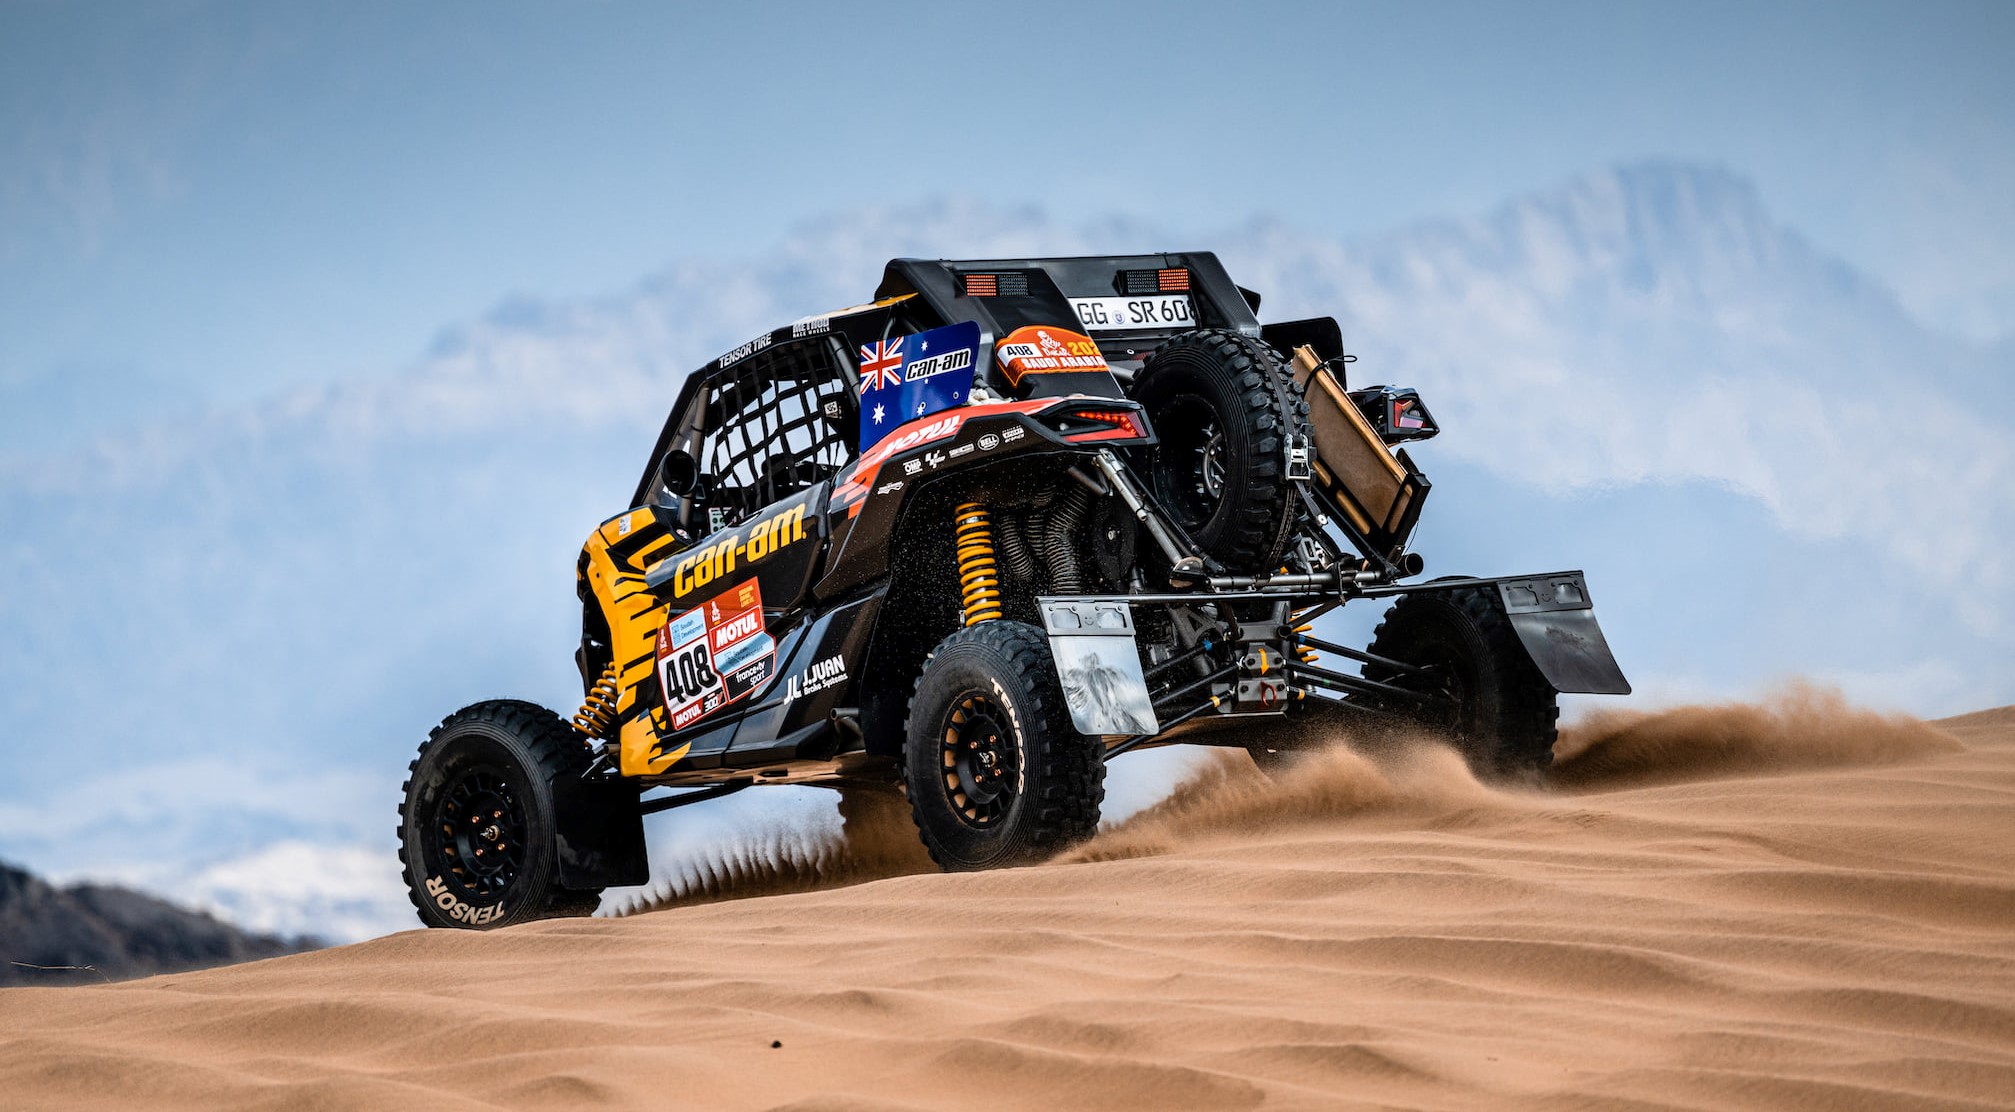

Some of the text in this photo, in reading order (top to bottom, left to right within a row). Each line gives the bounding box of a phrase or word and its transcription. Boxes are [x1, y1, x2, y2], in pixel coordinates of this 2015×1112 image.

[1077, 303, 1109, 325] GG
[1128, 301, 1159, 323] SR
[719, 332, 772, 369] TENSOR TIRE
[1007, 345, 1034, 357] 408
[1021, 356, 1107, 369] SAUDI ARABIA
[877, 415, 960, 461] MOTUL
[980, 436, 998, 447] BELL
[904, 460, 922, 473] OMP
[716, 612, 758, 648] MOTUL
[666, 643, 718, 704] 408
[750, 670, 765, 688] sport
[804, 673, 849, 696] Brake Systems
[675, 703, 702, 727] MOTUL
[991, 677, 1025, 795] TENSOR
[425, 875, 505, 925] TENSOR
